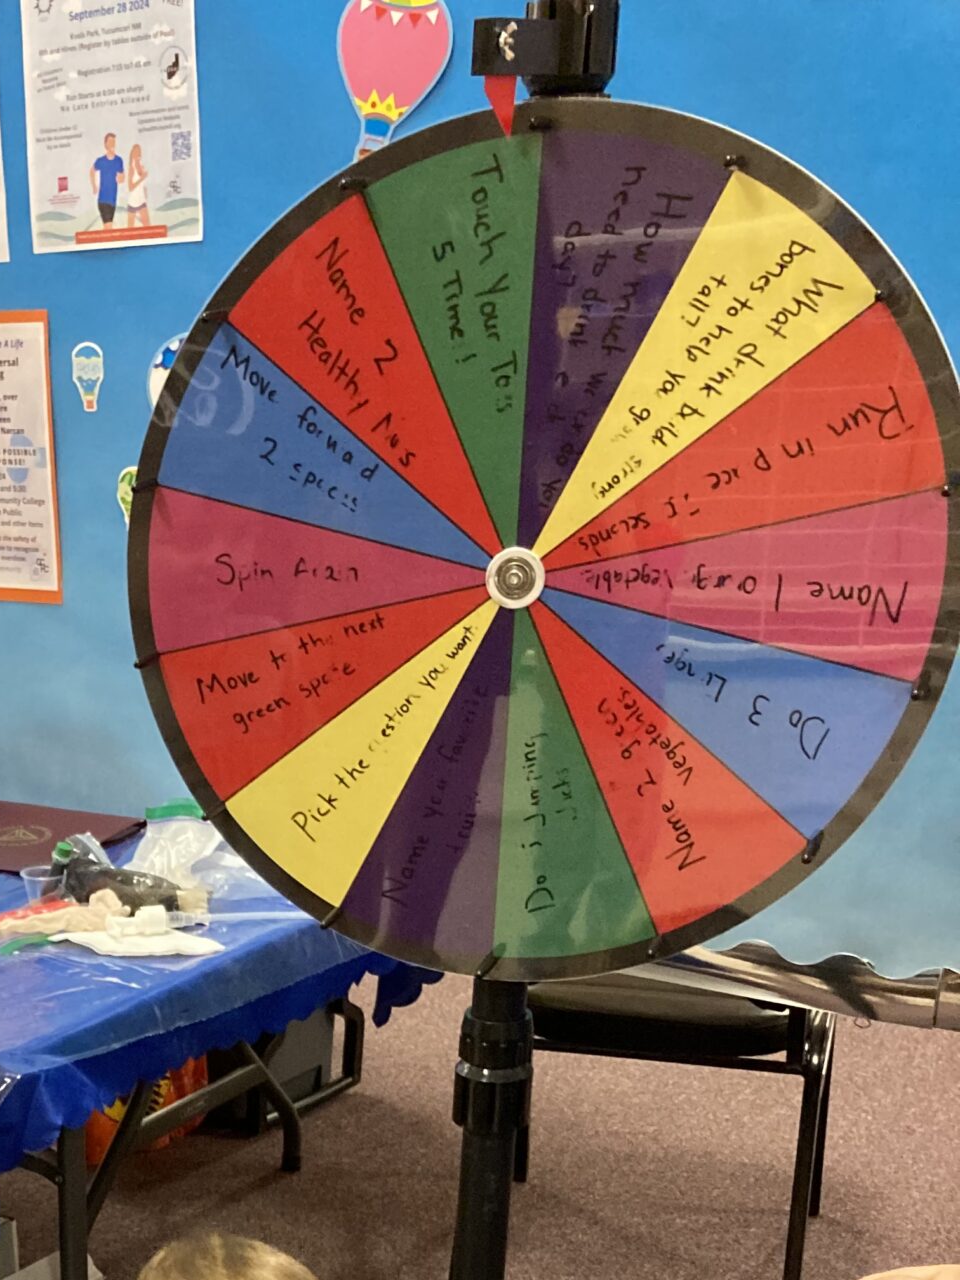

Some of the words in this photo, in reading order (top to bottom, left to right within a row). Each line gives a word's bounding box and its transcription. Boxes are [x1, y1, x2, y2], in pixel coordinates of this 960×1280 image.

[69, 7, 115, 22] September
[117, 3, 127, 13] 28
[129, 0, 150, 12] 2024
[471, 153, 507, 266] Touch
[599, 165, 648, 237] need
[632, 191, 694, 264] How
[432, 240, 455, 263] 5
[591, 249, 617, 278] to
[749, 239, 816, 294] bones
[315, 236, 366, 326] Name
[373, 338, 399, 377] 2
[474, 272, 510, 343] Your
[680, 273, 729, 328] tall?
[725, 296, 754, 318] to
[765, 277, 845, 340] What
[4, 340, 8, 348] A
[10, 339, 24, 350] Life
[296, 309, 370, 417] Healthy
[684, 324, 734, 363] help
[699, 342, 766, 399] drink
[220, 345, 278, 404] Move
[825, 385, 914, 441] Run
[258, 436, 278, 466] 2
[780, 437, 815, 461] in
[214, 552, 274, 592] Spin
[806, 580, 908, 627] Name
[195, 671, 261, 705] Move
[297, 632, 334, 655] th
[342, 612, 386, 637] next
[232, 696, 292, 734] green
[596, 696, 642, 761] geen
[747, 693, 771, 727] 3
[788, 708, 831, 761] Do
[290, 792, 339, 843] Pick
[337, 757, 371, 790] the
[636, 768, 658, 797] 2
[660, 799, 707, 872] Name
[523, 873, 557, 914] Do
